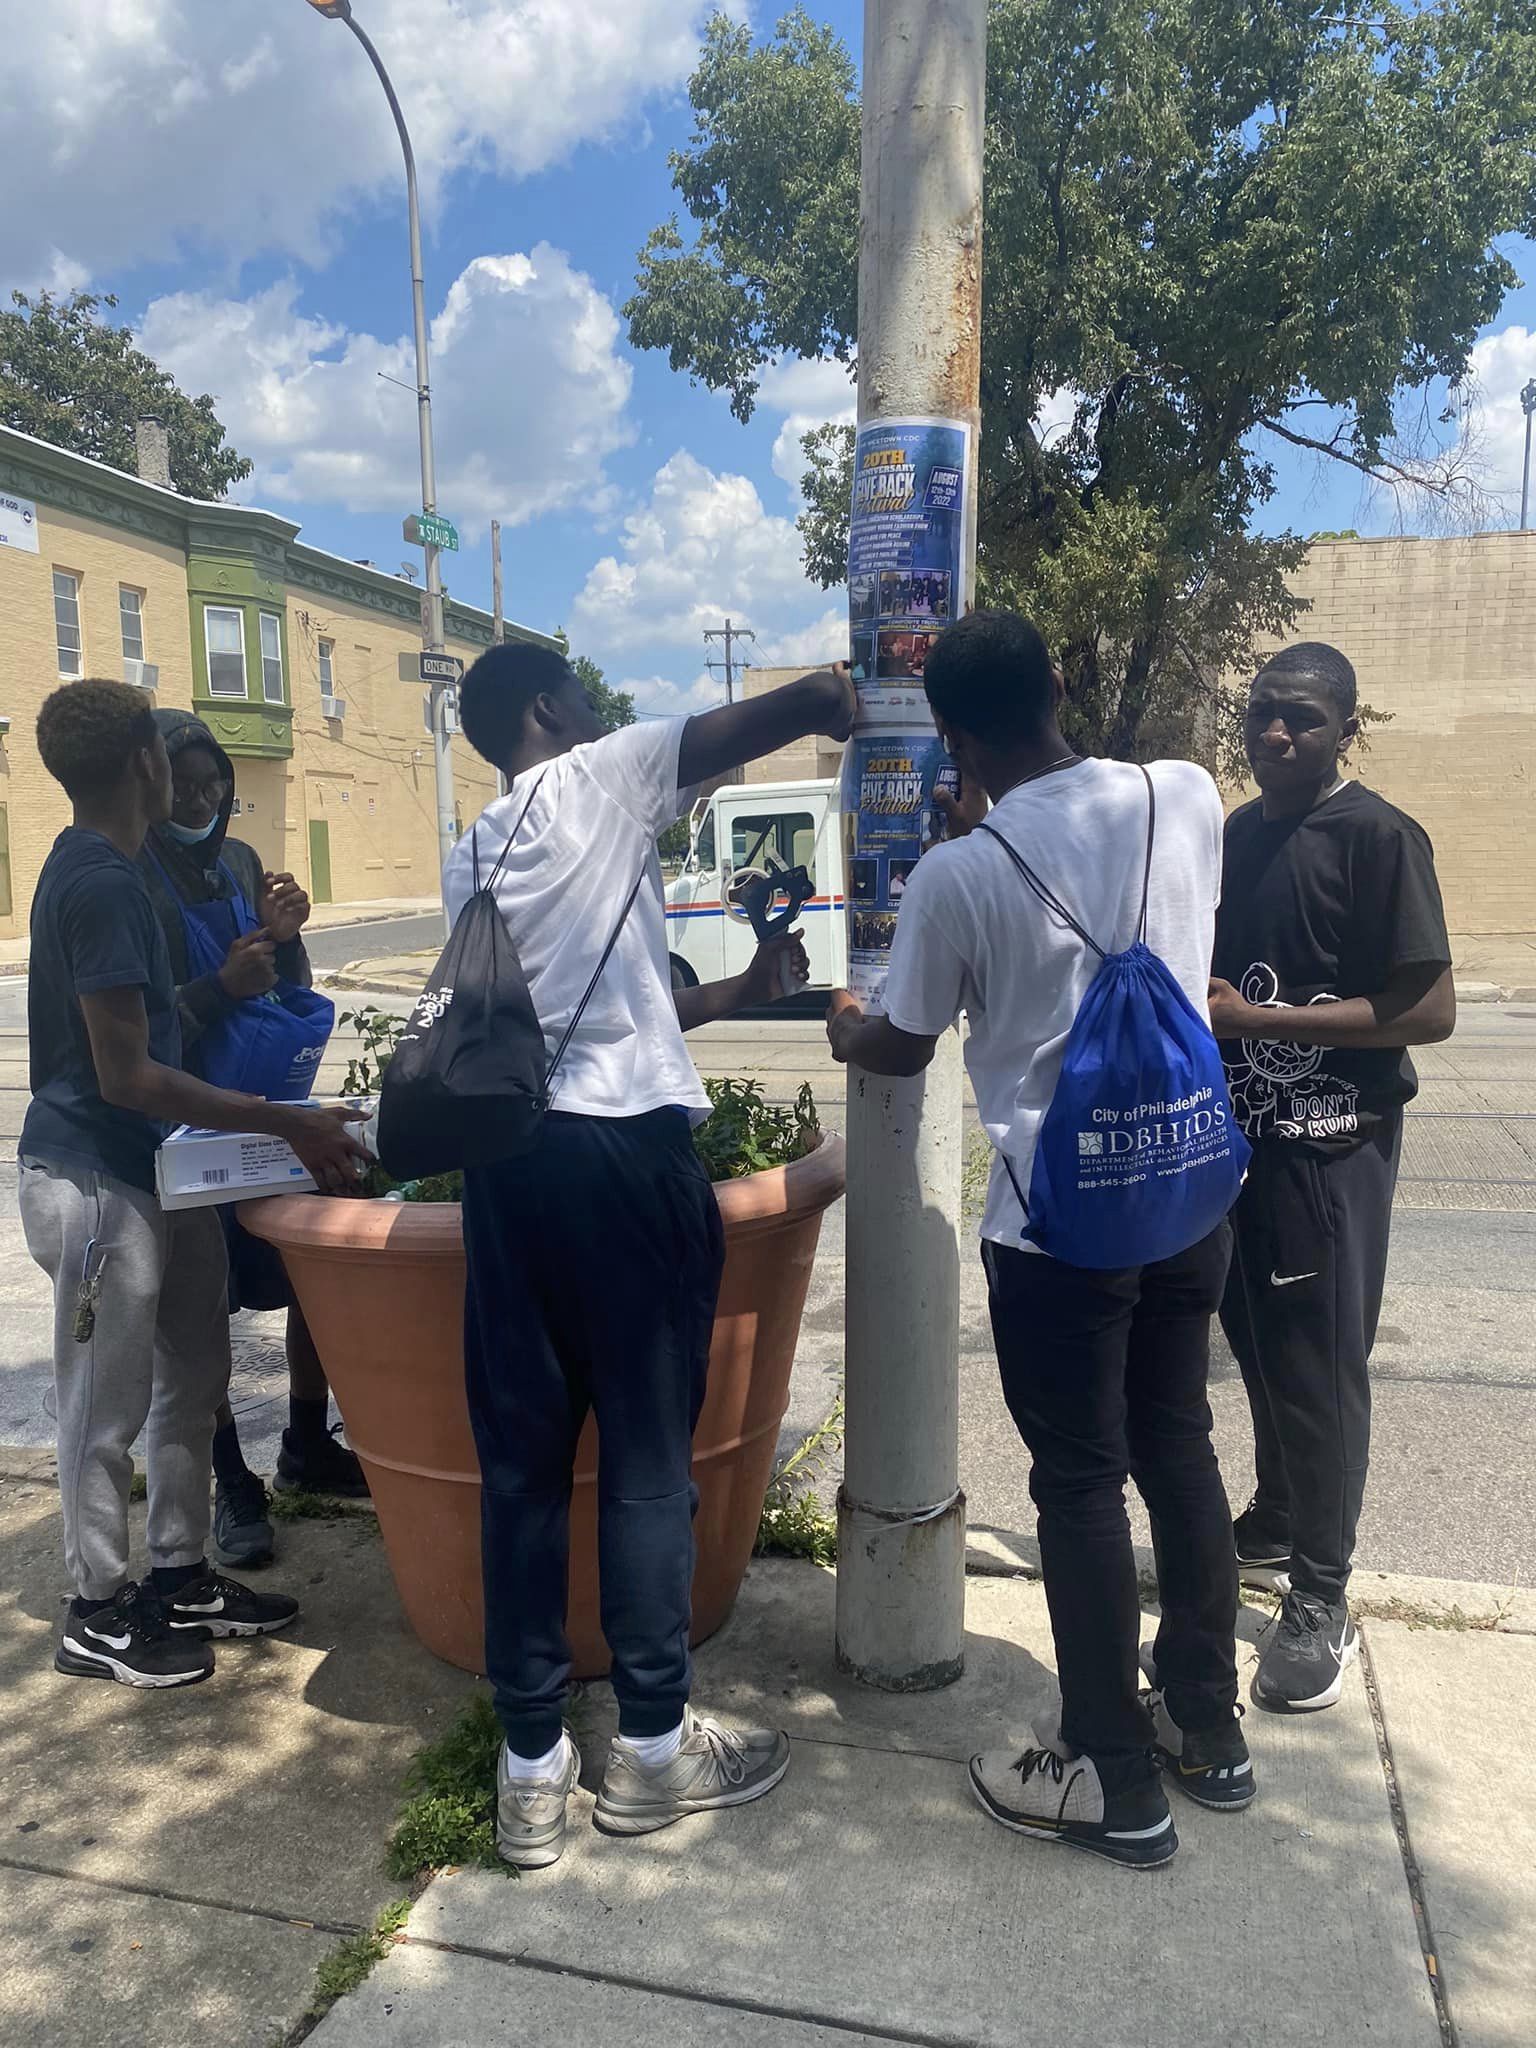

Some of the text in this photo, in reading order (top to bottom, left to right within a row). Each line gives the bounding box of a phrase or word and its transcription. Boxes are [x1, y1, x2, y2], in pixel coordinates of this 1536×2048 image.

[863, 450, 905, 468] 20TH
[932, 471, 958, 486] AUGUST
[932, 495, 951, 506] 2022
[426, 525, 450, 547] STAUB
[426, 660, 442, 672] ONE
[867, 758, 912, 772] 20TH
[861, 772, 923, 780] ANNIVERSARY
[861, 780, 923, 803] GIVE BACK
[860, 795, 923, 815] Festival
[1092, 1086, 1213, 1124] City of Philadelphia
[1291, 1093, 1359, 1121] DON'T
[1108, 1101, 1227, 1154] DBHIDS
[1307, 1113, 1358, 1137] RUN
[1079, 1154, 1139, 1166] DEPARTMENT
[1092, 1158, 1155, 1174] INTELLECTUAL
[1077, 1173, 1147, 1190] 888-545-2600
